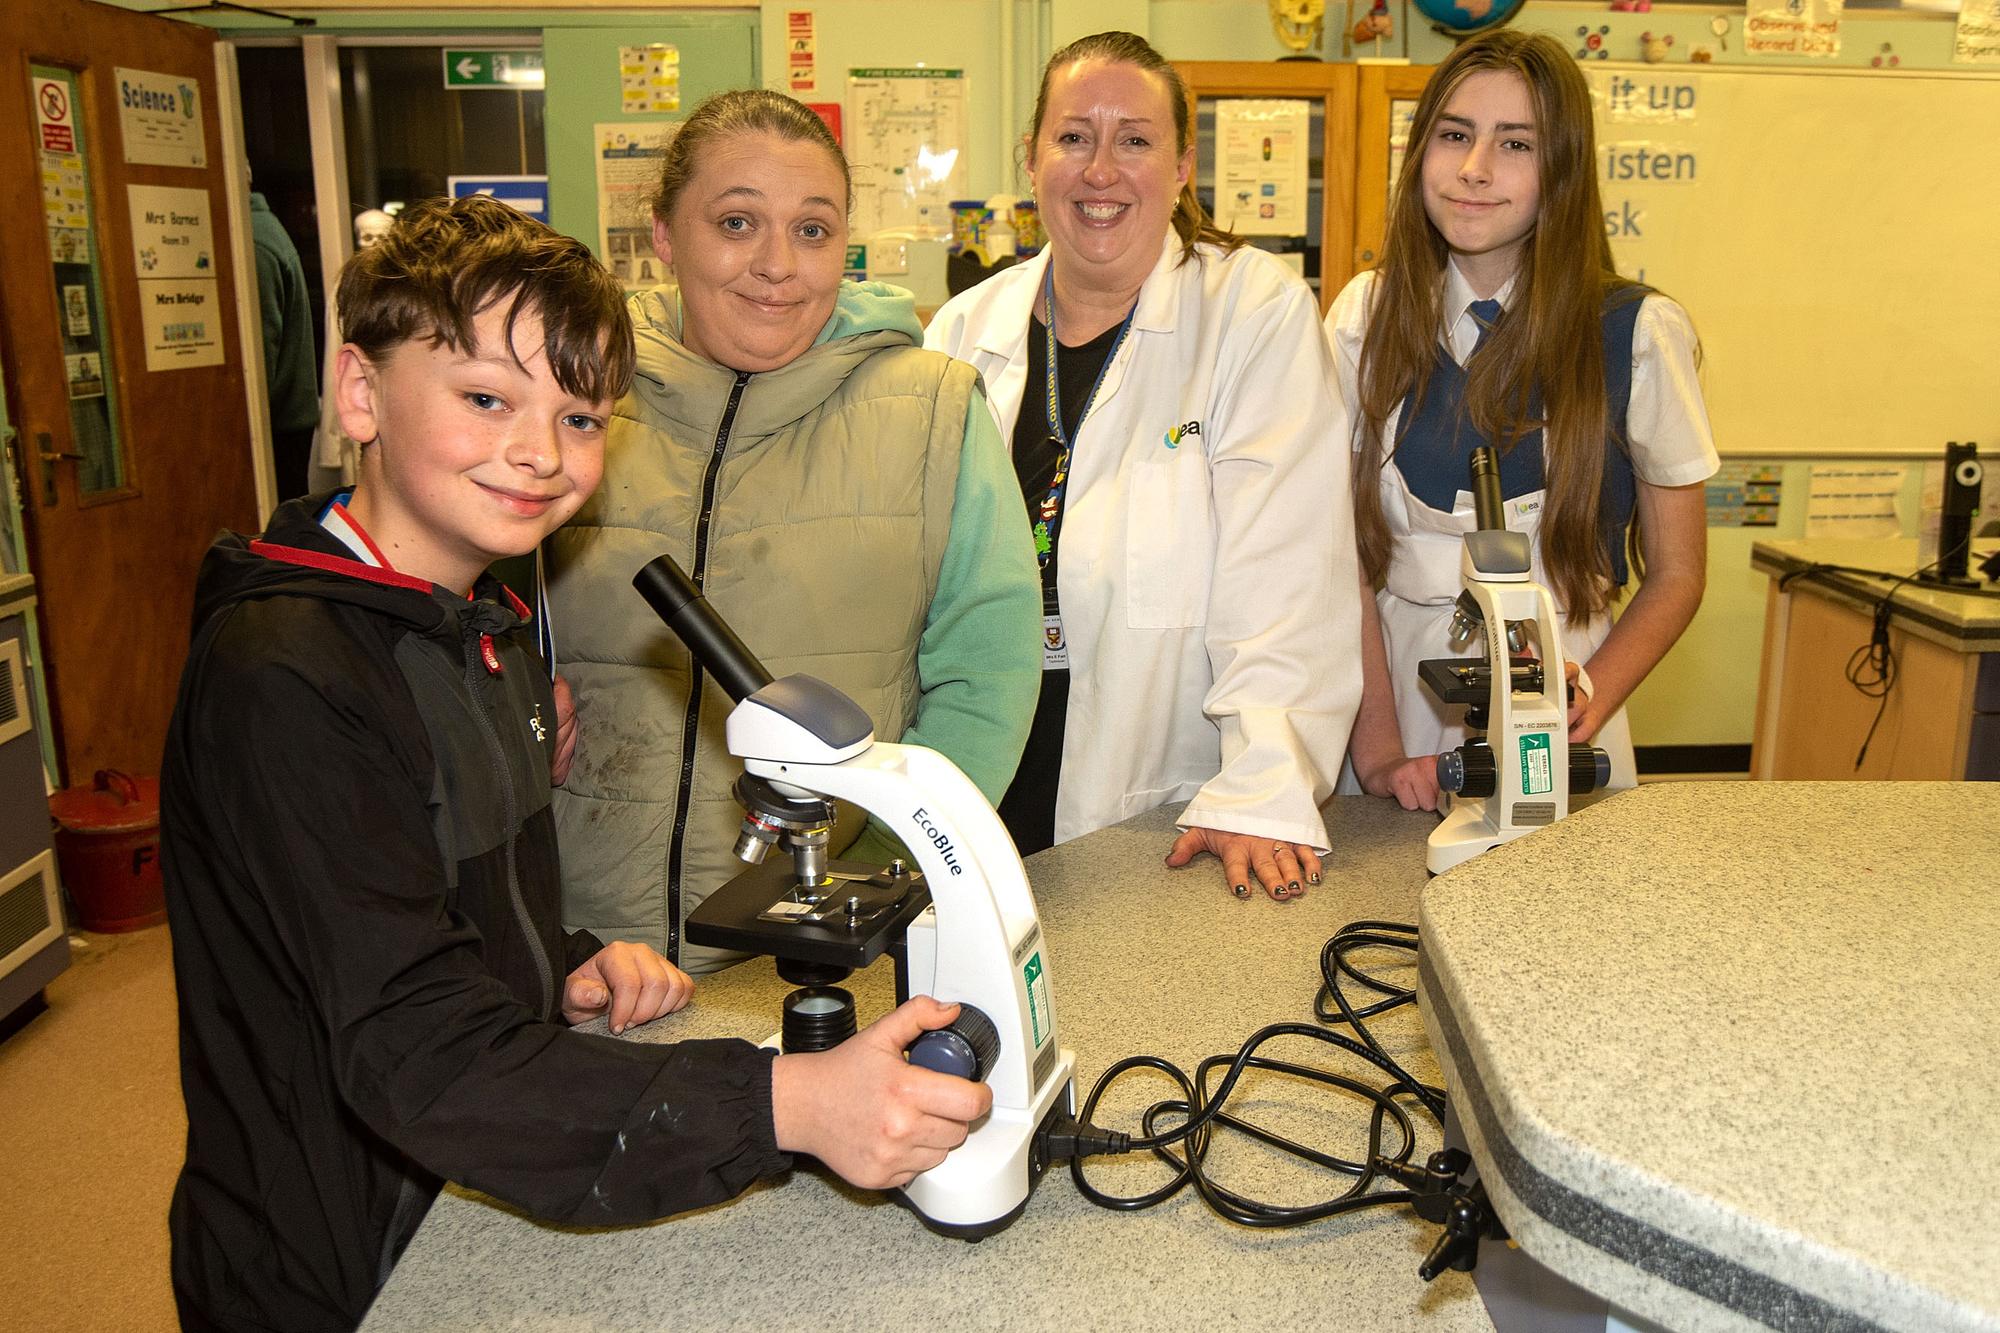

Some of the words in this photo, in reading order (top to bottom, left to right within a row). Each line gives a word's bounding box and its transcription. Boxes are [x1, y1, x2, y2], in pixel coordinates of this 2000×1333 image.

[1801, 38, 1835, 53] Daa
[122, 80, 176, 112] Science
[1610, 76, 1635, 110] it
[1648, 84, 1695, 116] up
[1607, 149, 1696, 180] isten
[145, 211, 165, 225] Mrs
[170, 211, 200, 227] Barnes
[155, 294, 175, 305] Mrs
[176, 293, 205, 306] Bridge
[1180, 420, 1201, 438] ea
[912, 807, 962, 876] EcoBlue
